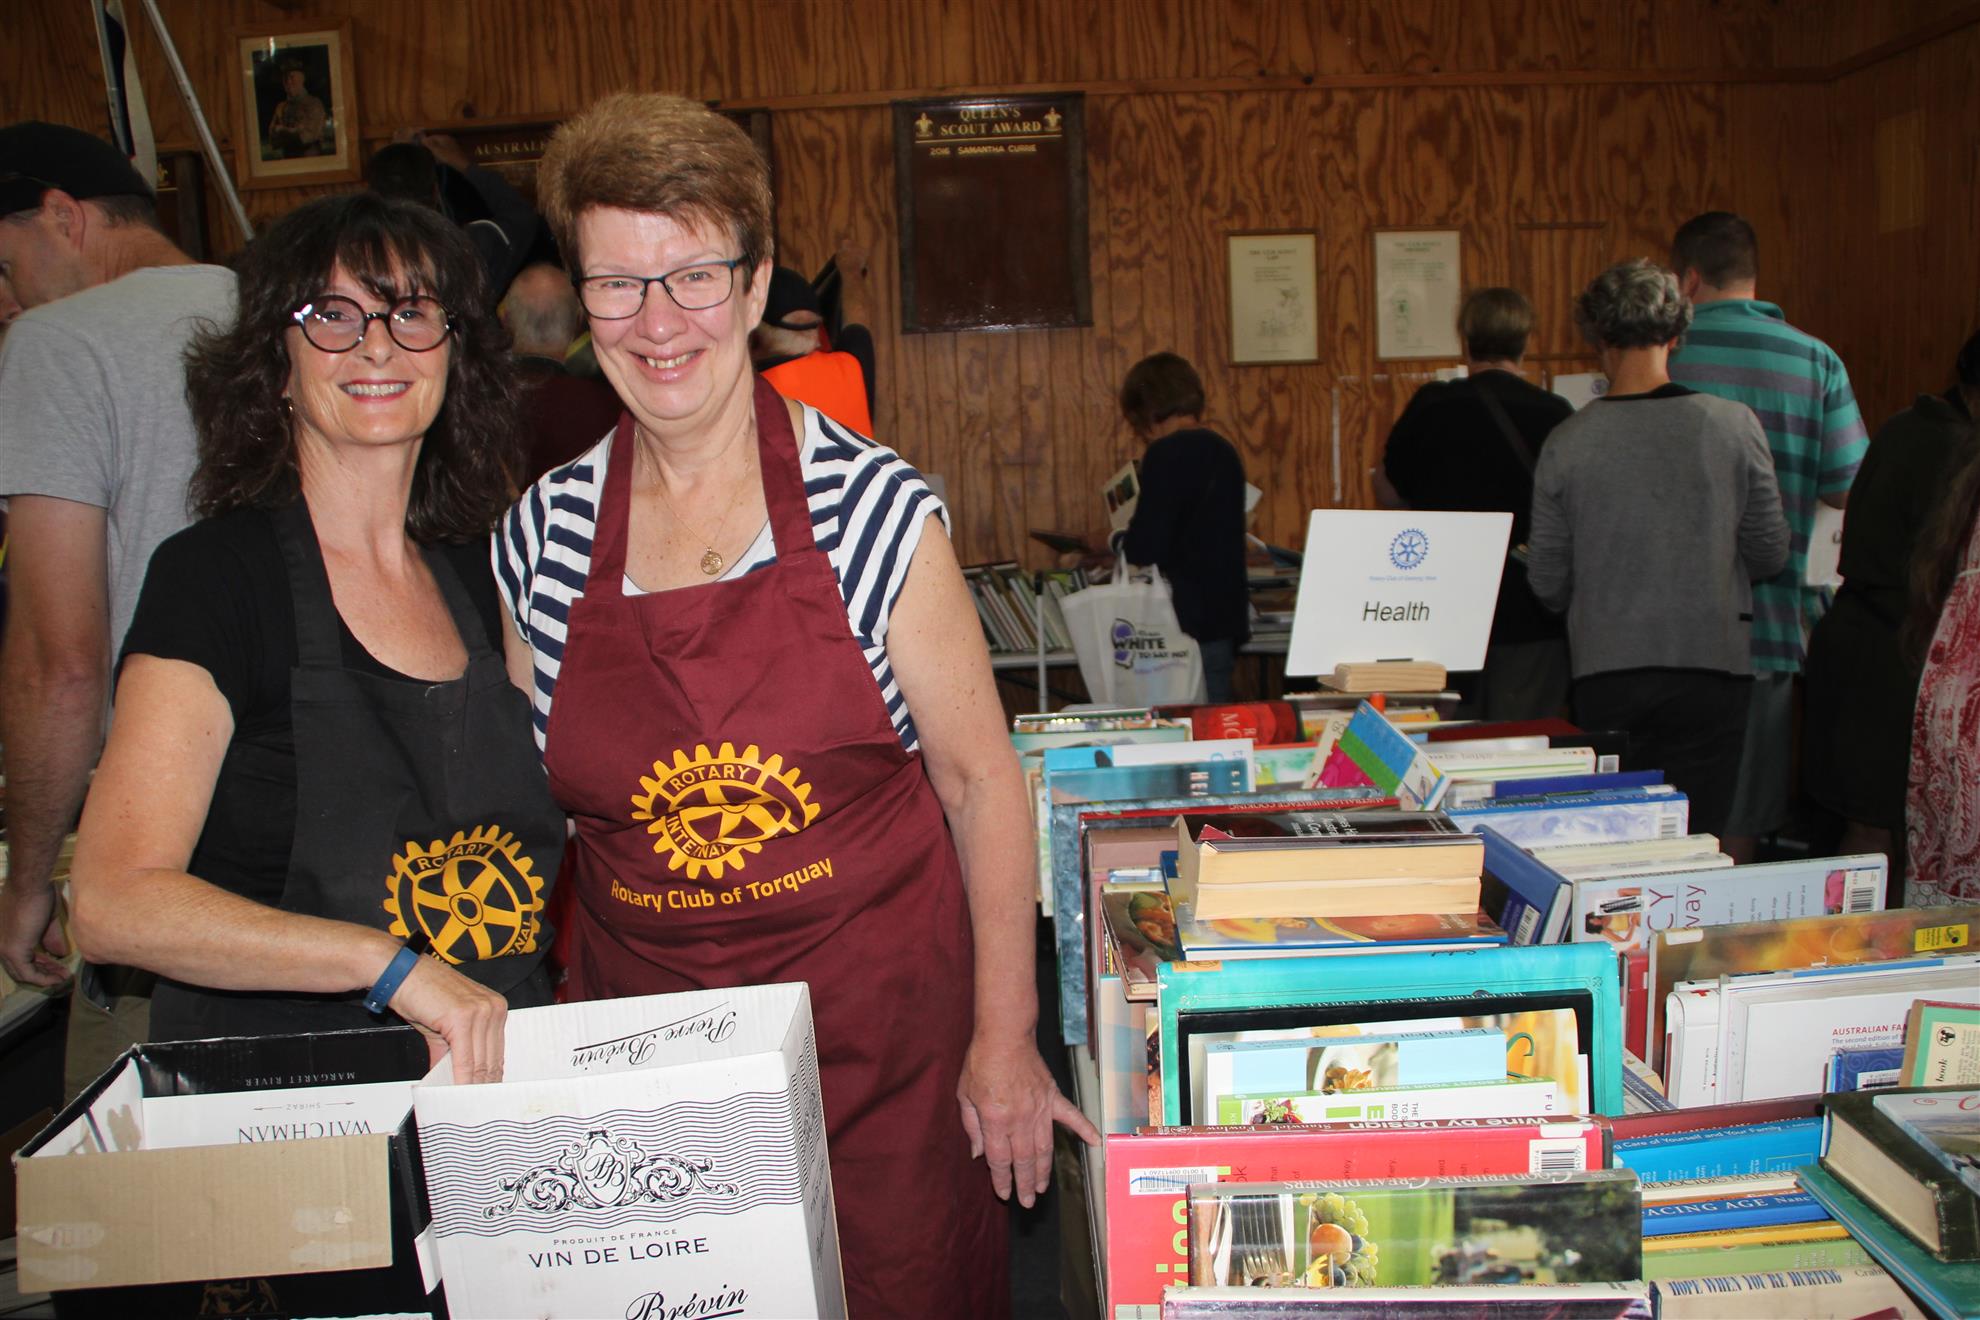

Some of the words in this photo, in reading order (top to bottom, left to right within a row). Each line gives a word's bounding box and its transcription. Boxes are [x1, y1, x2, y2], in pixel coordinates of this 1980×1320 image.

[960, 107, 1021, 121] QUEEN'S
[941, 124, 988, 136] SCOUT
[992, 121, 1041, 133] AWARD
[1362, 601, 1430, 621] Health
[1113, 637, 1166, 649] WHITE
[669, 765, 751, 791] ROTARY
[666, 815, 729, 859] INTENAT
[416, 843, 488, 871] ROTARY
[611, 879, 662, 912] Rotary
[667, 889, 715, 909] Club
[720, 886, 742, 905] of
[746, 857, 833, 900] Torquay
[664, 1011, 737, 1044] Pierre
[1832, 1025, 1889, 1036] AUSTRALIAN
[570, 1033, 657, 1071] Brévin
[288, 1072, 356, 1084] MARGARET
[1935, 1057, 1949, 1083] book
[245, 1077, 282, 1087] RIVER
[286, 1102, 321, 1111] SHIRAZ
[1349, 1119, 1440, 1129] Design
[1448, 1118, 1480, 1127] by
[1490, 1116, 1549, 1126] Wine
[238, 1120, 373, 1144] WATCHMAN
[1623, 1140, 1647, 1149] Care
[1650, 1138, 1661, 1146] of
[1663, 1134, 1702, 1144] Yourself
[1725, 1129, 1747, 1137] Your
[1750, 1125, 1782, 1135] Family
[1284, 1178, 1361, 1190] DINNERS
[1366, 1175, 1430, 1189] GREAT
[1664, 1175, 1722, 1187] DOCTORS
[1642, 1203, 1717, 1217] ACING
[1725, 1198, 1768, 1210] AGE
[1776, 1196, 1811, 1204] Nanc
[610, 1234, 626, 1242] DE
[630, 1228, 678, 1239] FRANCE
[529, 1251, 573, 1268] VIN
[584, 1247, 619, 1265] DE
[629, 1237, 710, 1260] LOIRE
[1668, 1278, 1704, 1296] HOPE
[1702, 1275, 1742, 1293] WHEN
[1742, 1273, 1788, 1290] YOU'RE
[1792, 1268, 1842, 1288] HURTING
[625, 1284, 750, 1320] Brévin
